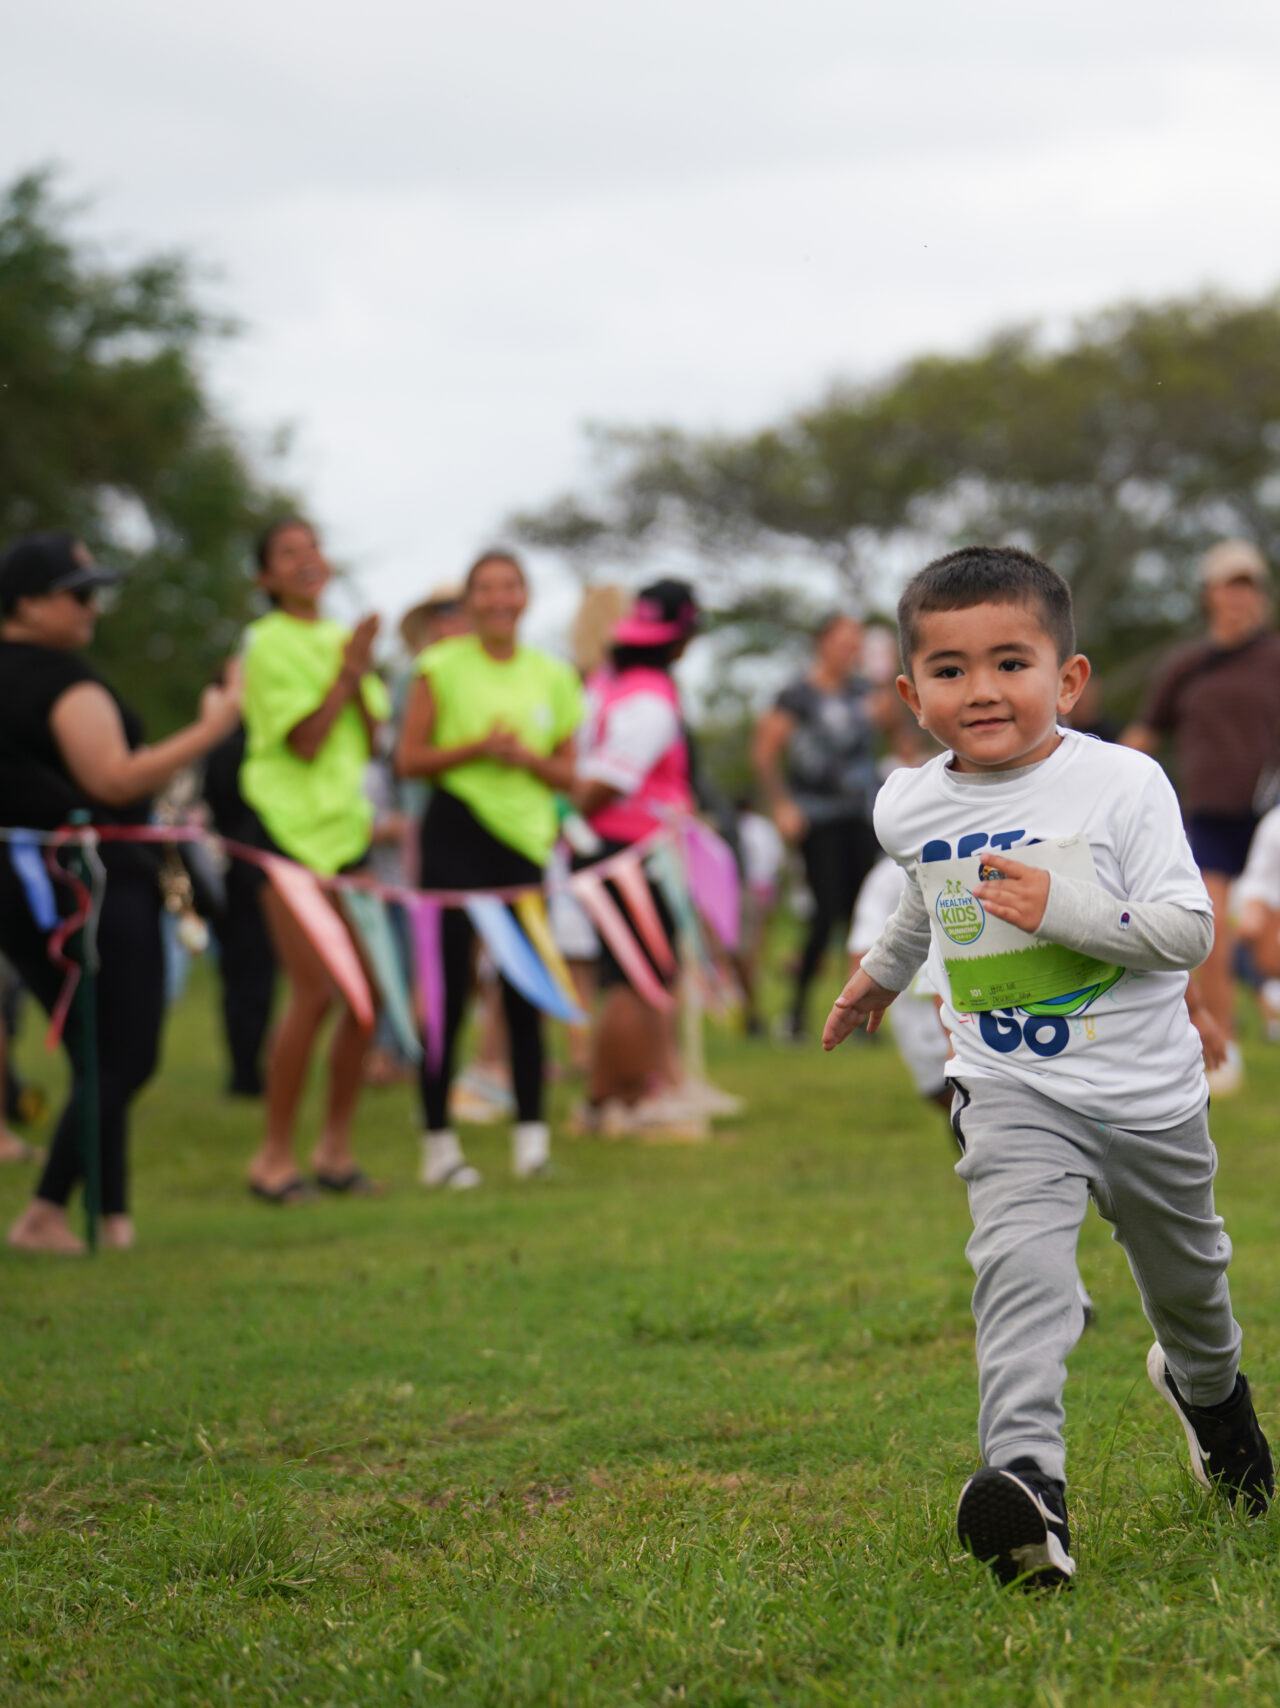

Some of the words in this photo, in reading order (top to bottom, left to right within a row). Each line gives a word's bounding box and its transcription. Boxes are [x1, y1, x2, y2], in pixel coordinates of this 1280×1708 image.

[940, 897, 973, 908] HEALTHY
[941, 905, 978, 925] KIDS
[979, 1007, 1070, 1057] GO
